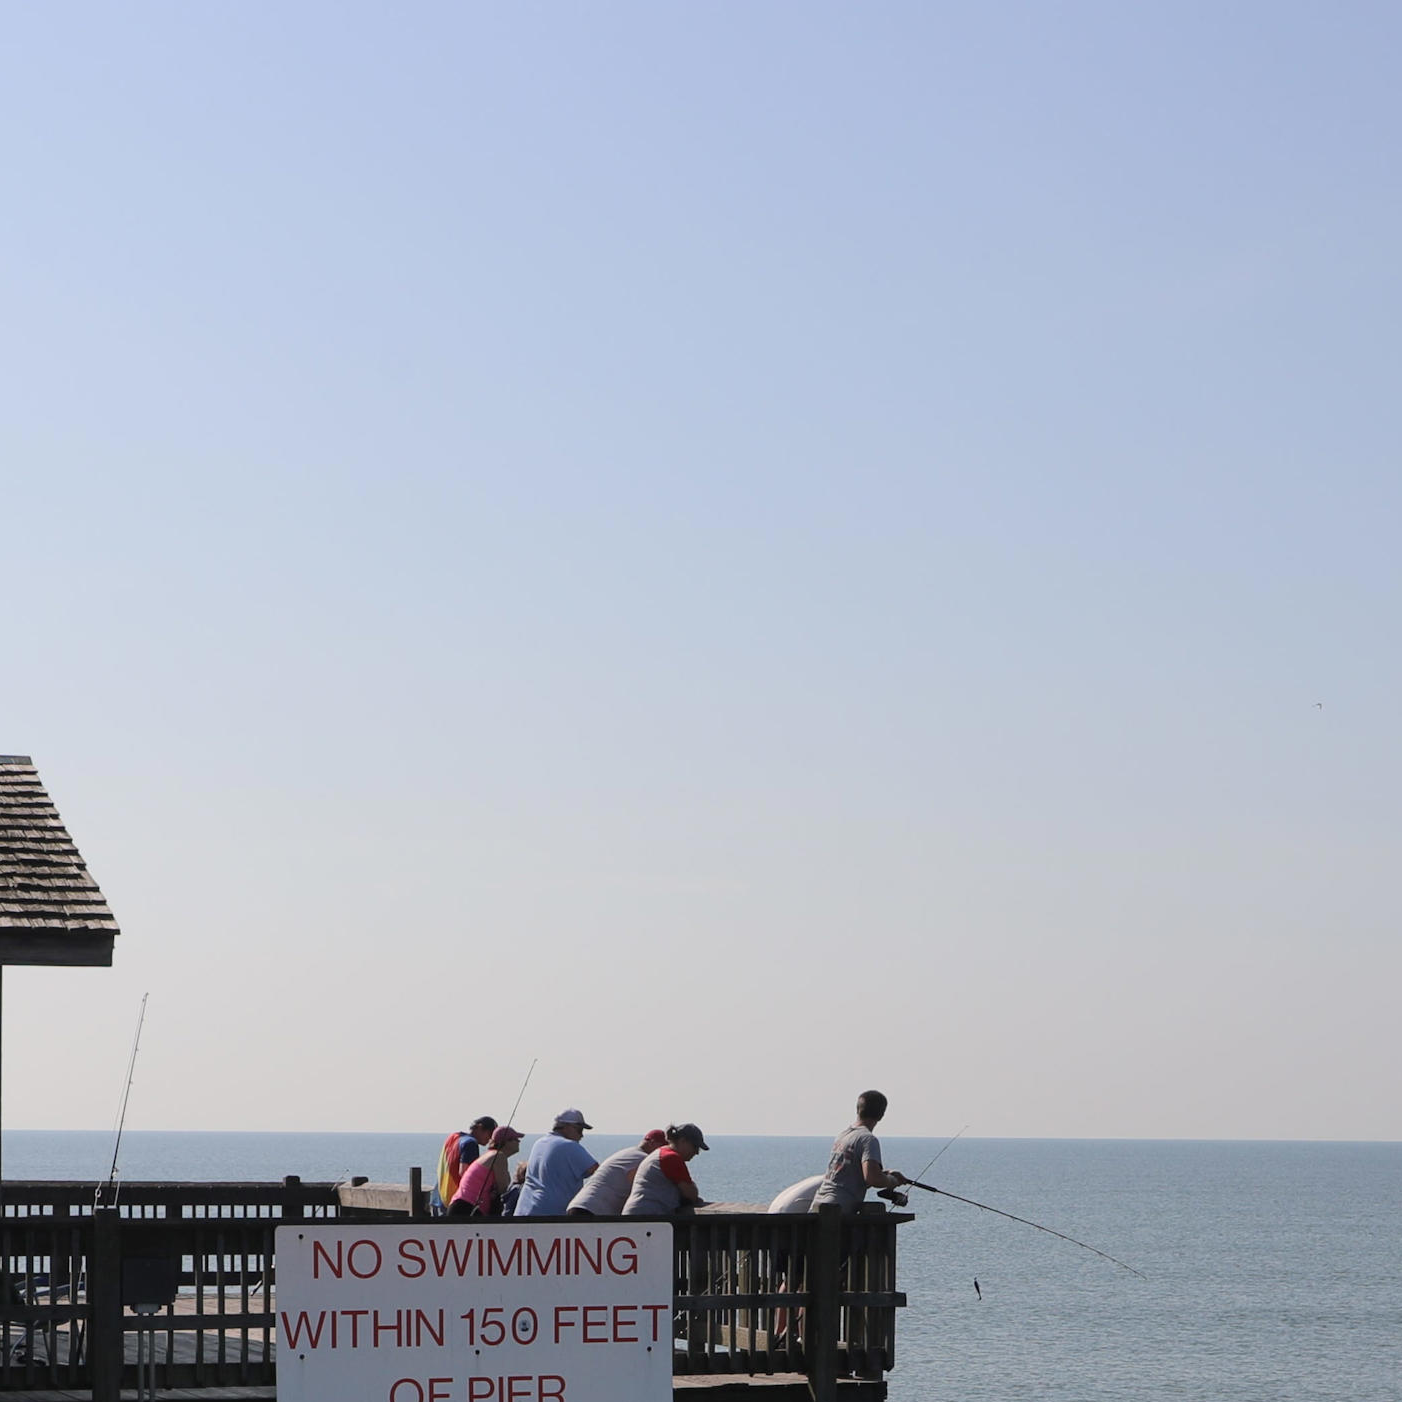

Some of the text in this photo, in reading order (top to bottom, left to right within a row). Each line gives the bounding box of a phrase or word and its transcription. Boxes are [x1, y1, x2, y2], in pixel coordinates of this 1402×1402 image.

[313, 1237, 638, 1279] NO SWIMMING
[281, 1305, 668, 1349] WITHIN 150 FEET
